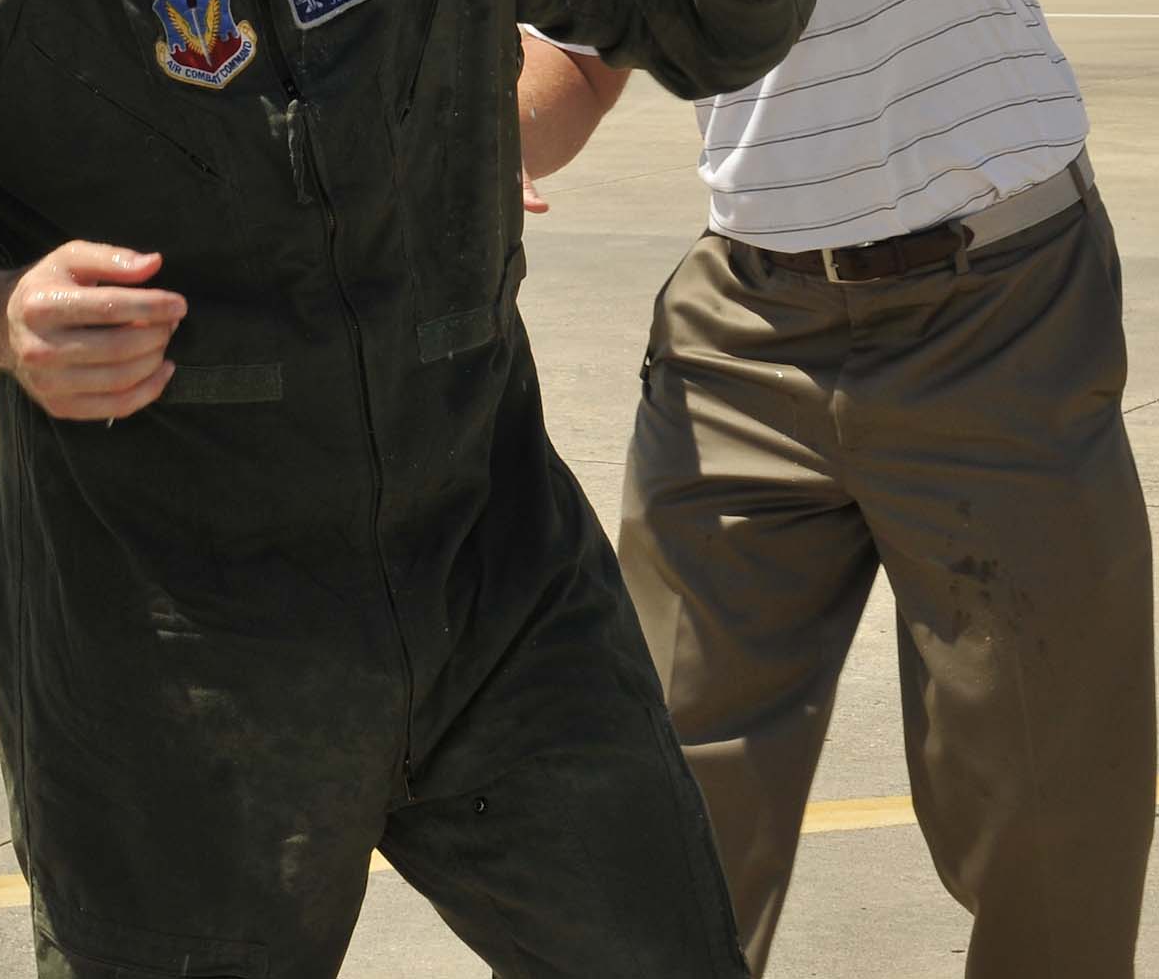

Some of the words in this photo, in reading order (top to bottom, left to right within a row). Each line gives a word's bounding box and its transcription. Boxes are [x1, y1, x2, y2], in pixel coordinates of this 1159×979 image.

[167, 60, 182, 74] AIR
[185, 68, 221, 84] COMBAT
[221, 41, 252, 78] COMMAND
